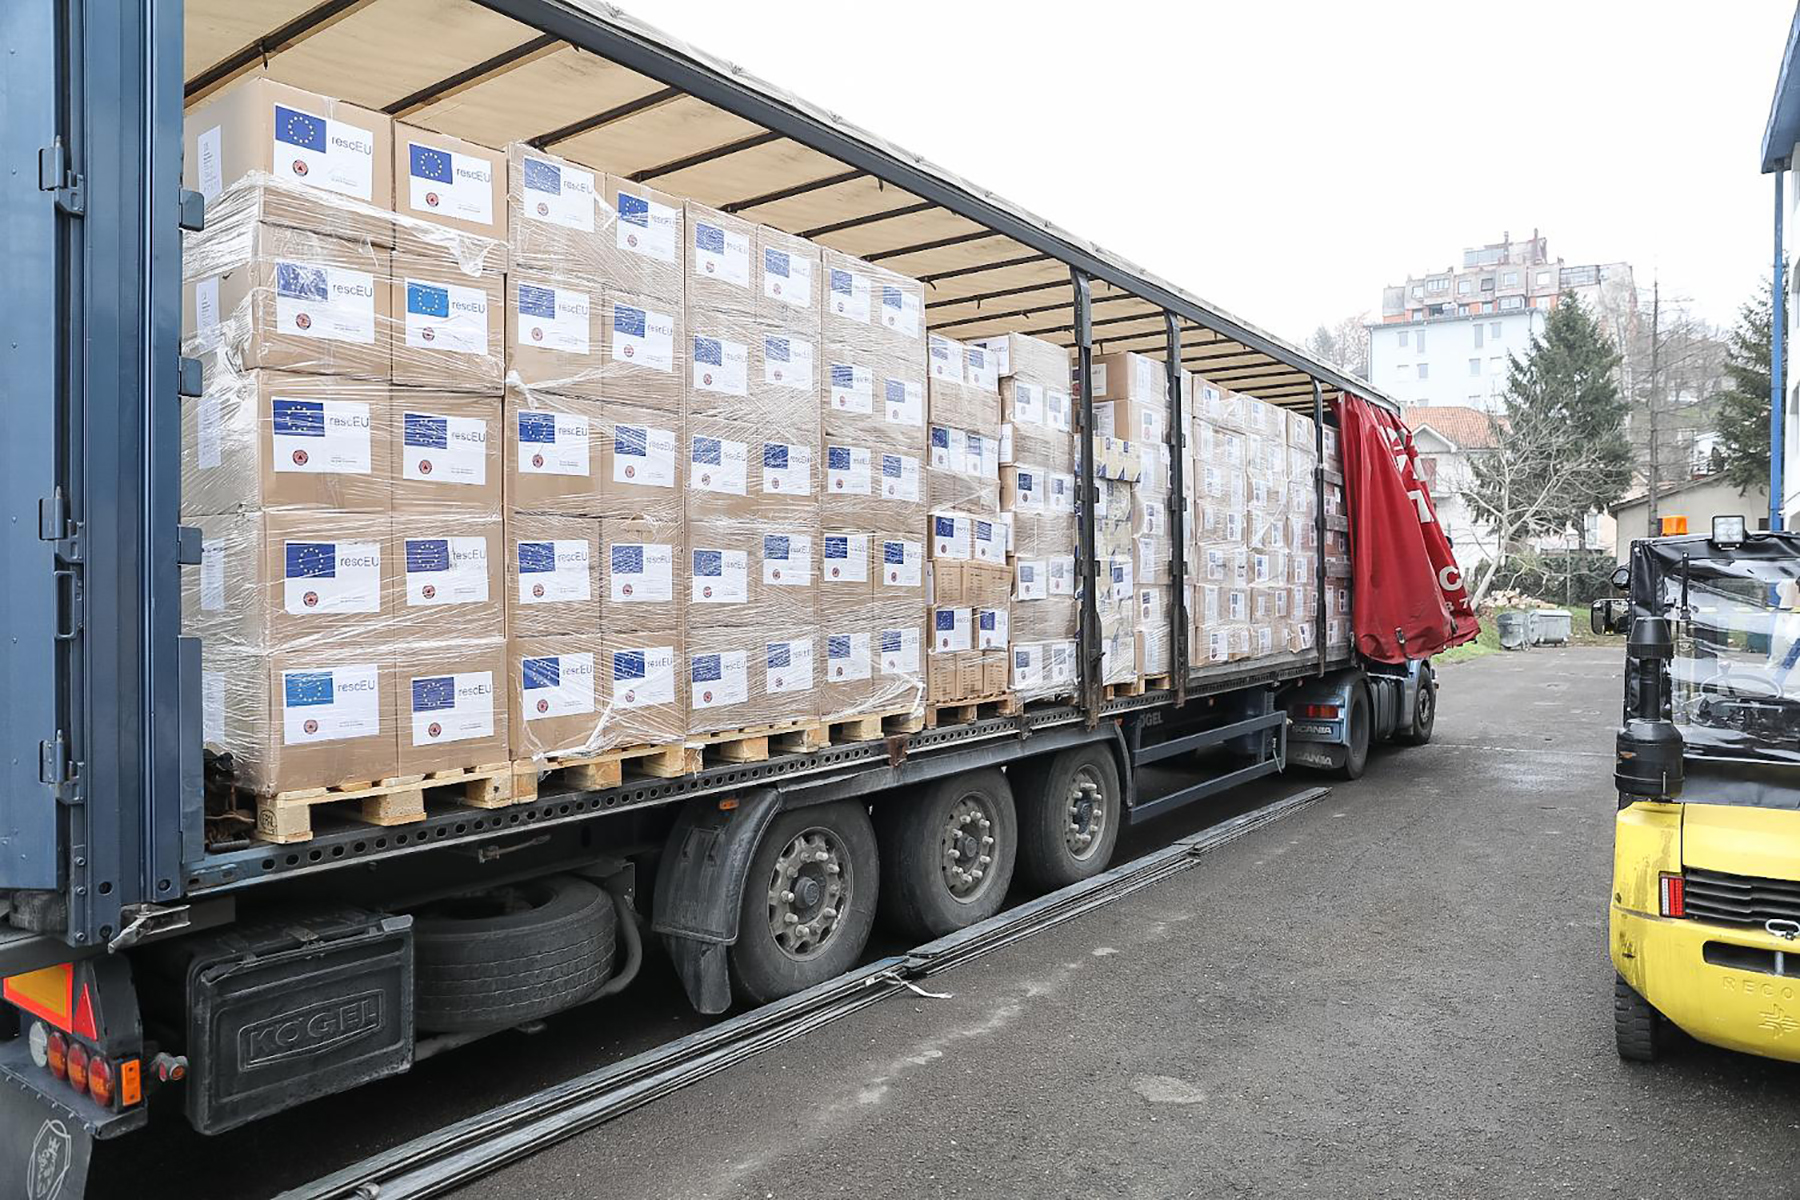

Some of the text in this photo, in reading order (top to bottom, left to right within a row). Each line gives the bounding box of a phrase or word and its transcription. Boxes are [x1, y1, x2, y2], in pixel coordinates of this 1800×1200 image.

[332, 136, 371, 156] rescEU
[457, 168, 490, 183] rescEU
[564, 181, 593, 193] rescEU
[333, 284, 372, 298] rescEU
[452, 301, 486, 314] rescEU
[559, 304, 588, 315] rescEU
[330, 416, 369, 428] rescEU
[451, 432, 486, 443] rescEU
[558, 427, 587, 437] rescEU
[453, 549, 487, 560] rescEU
[558, 552, 588, 562] rescEU
[340, 556, 379, 567] rescEU
[1439, 566, 1463, 591] C
[563, 665, 592, 676] rescEU
[338, 680, 376, 693] rescEU
[458, 684, 491, 697] rescEU
